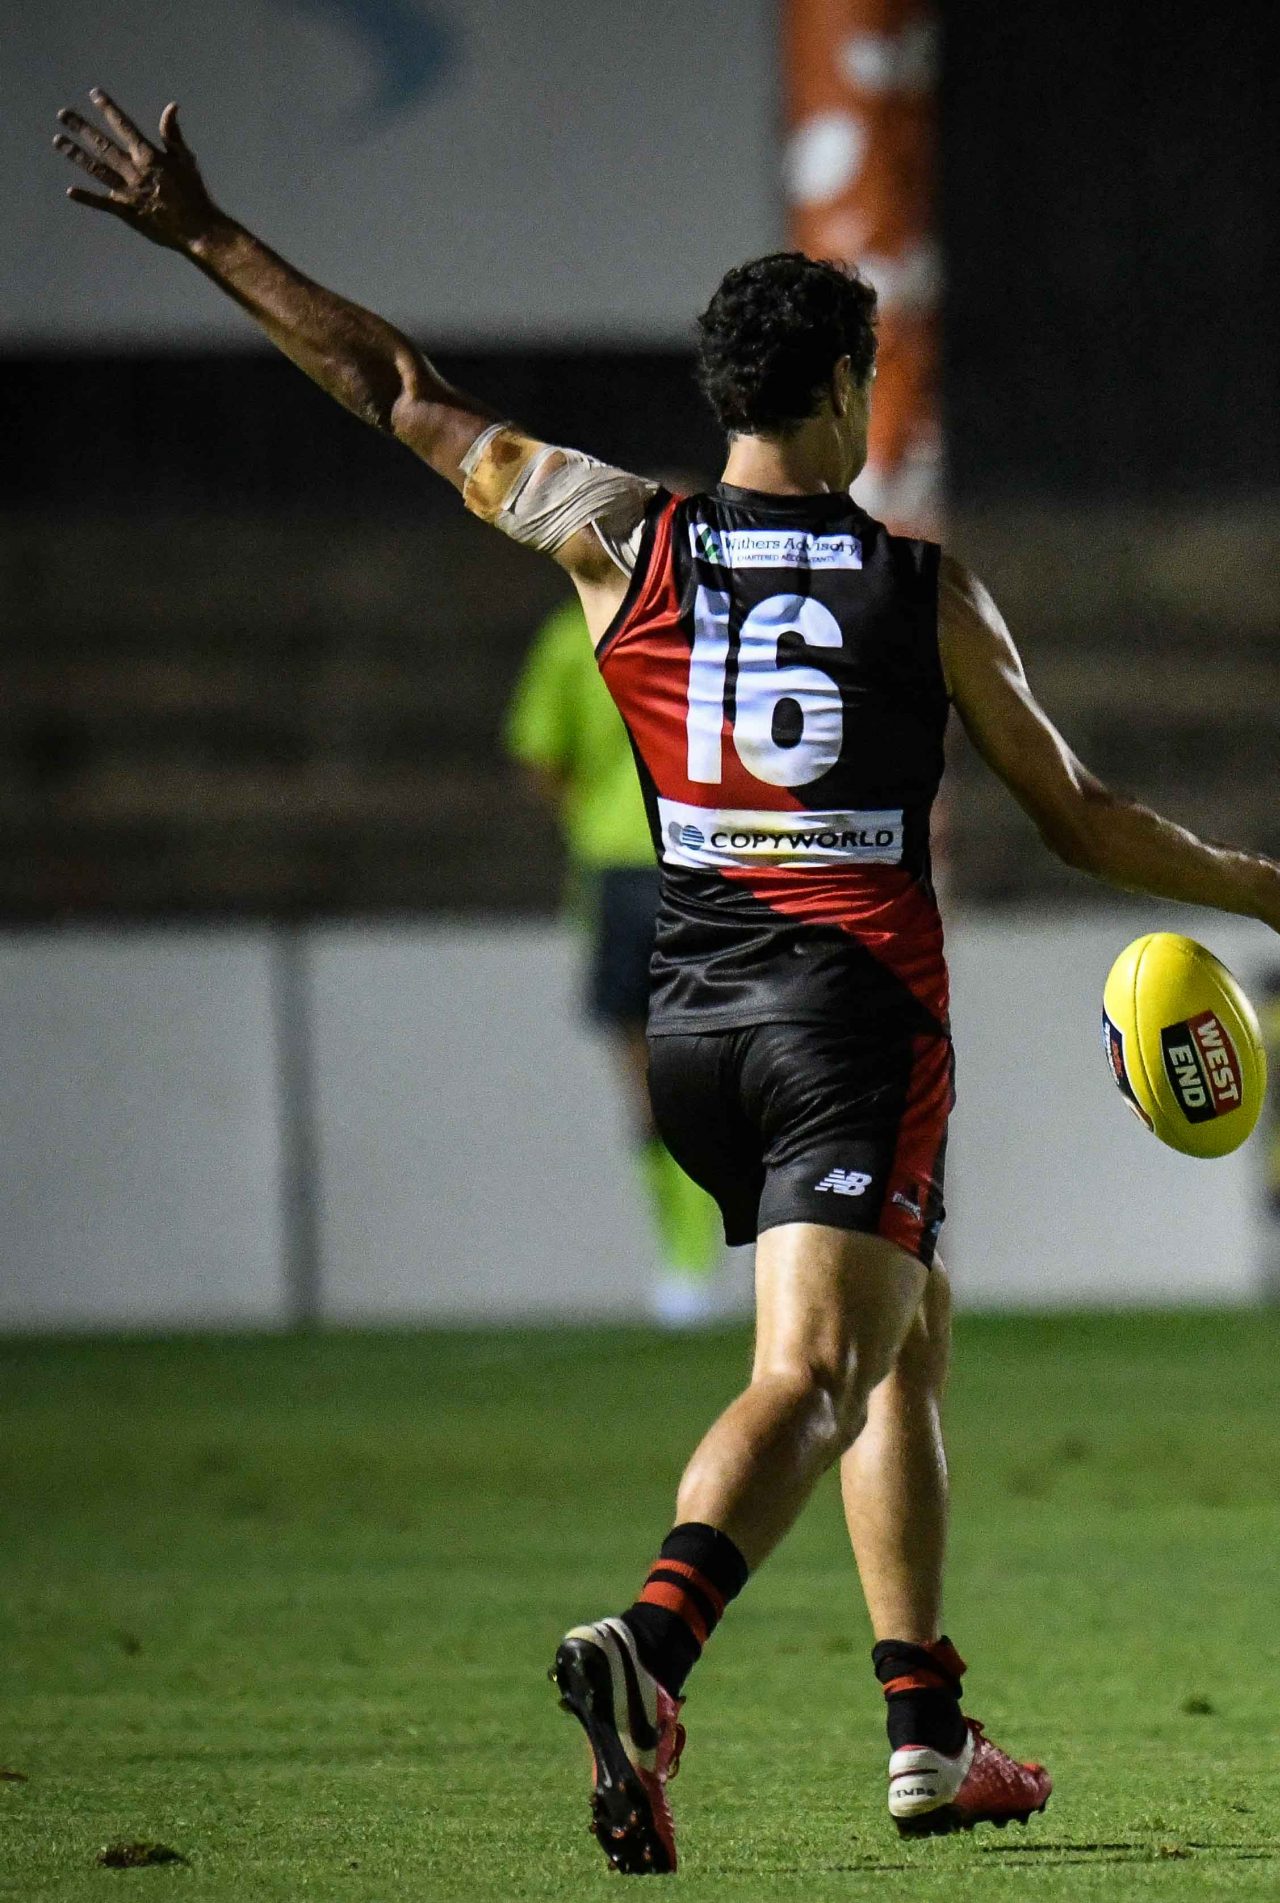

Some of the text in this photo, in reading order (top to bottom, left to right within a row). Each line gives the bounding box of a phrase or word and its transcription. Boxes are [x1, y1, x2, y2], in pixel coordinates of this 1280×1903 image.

[784, 537, 858, 556] Advisory
[686, 585, 843, 787] 16
[710, 829, 894, 849] COPYWORLD
[1168, 1044, 1207, 1108] END
[1197, 1018, 1240, 1102] WEST
